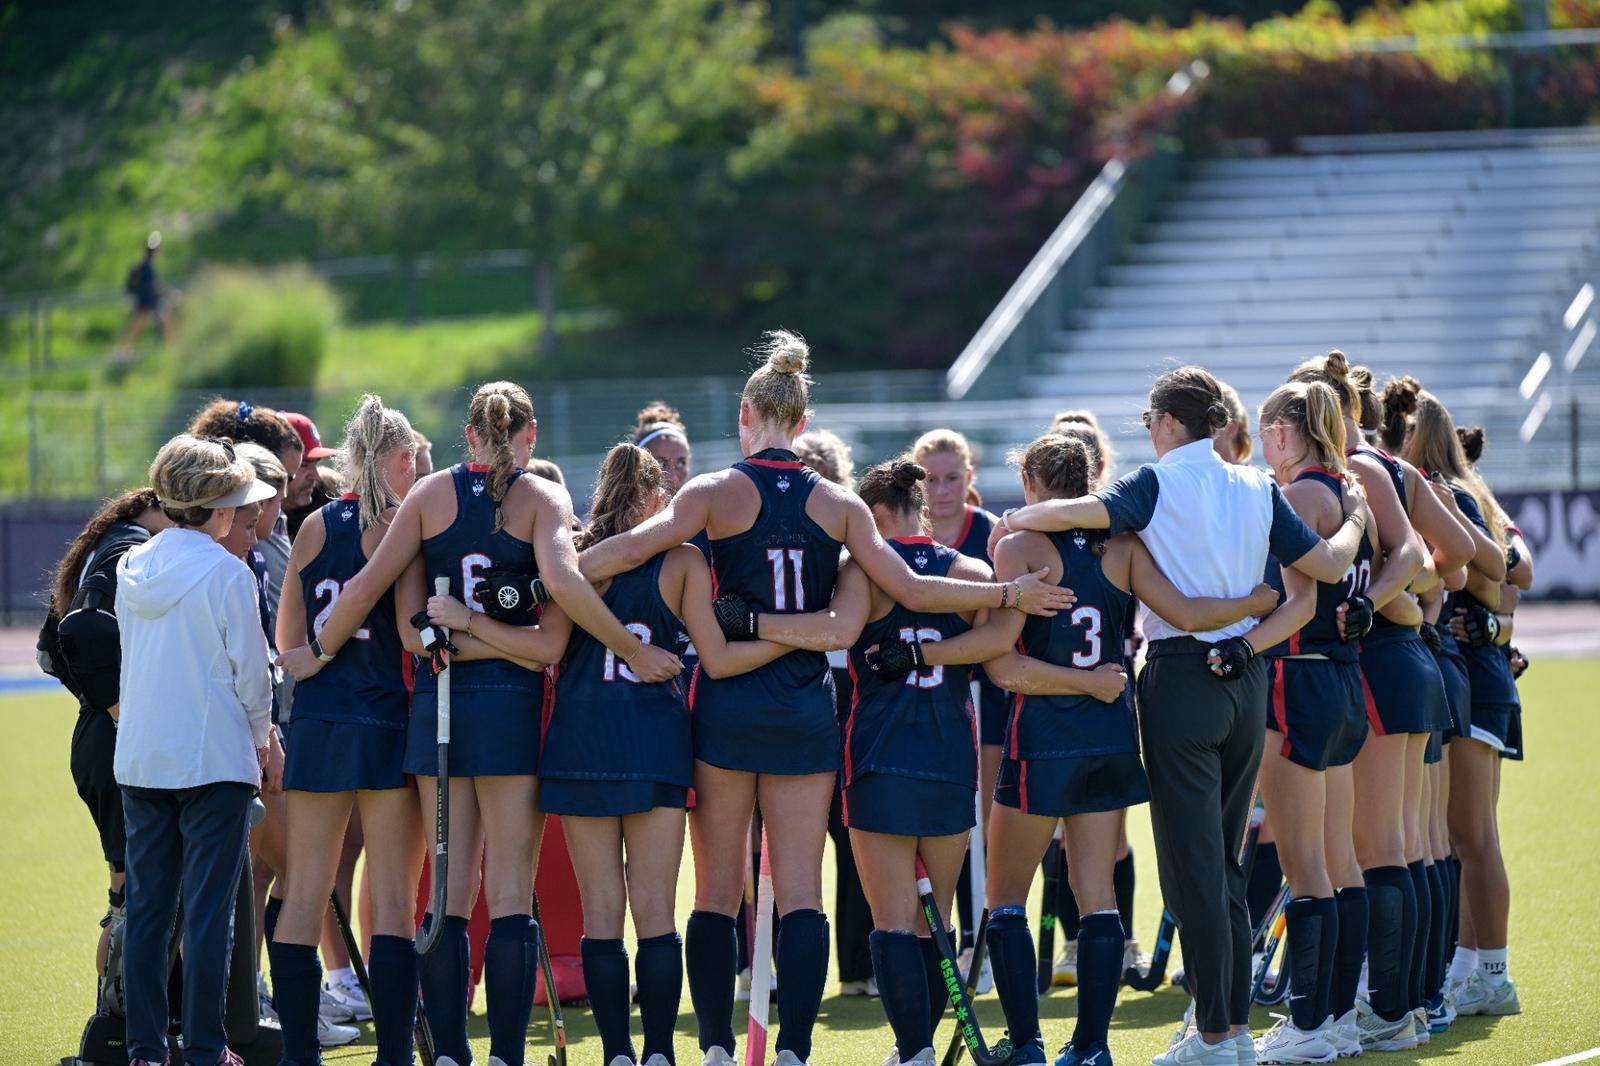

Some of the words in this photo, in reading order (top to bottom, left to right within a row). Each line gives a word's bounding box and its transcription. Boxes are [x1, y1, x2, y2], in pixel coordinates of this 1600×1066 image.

[767, 549, 805, 610] 11
[1071, 606, 1101, 667] 3
[940, 958, 963, 1005] OSAKA
